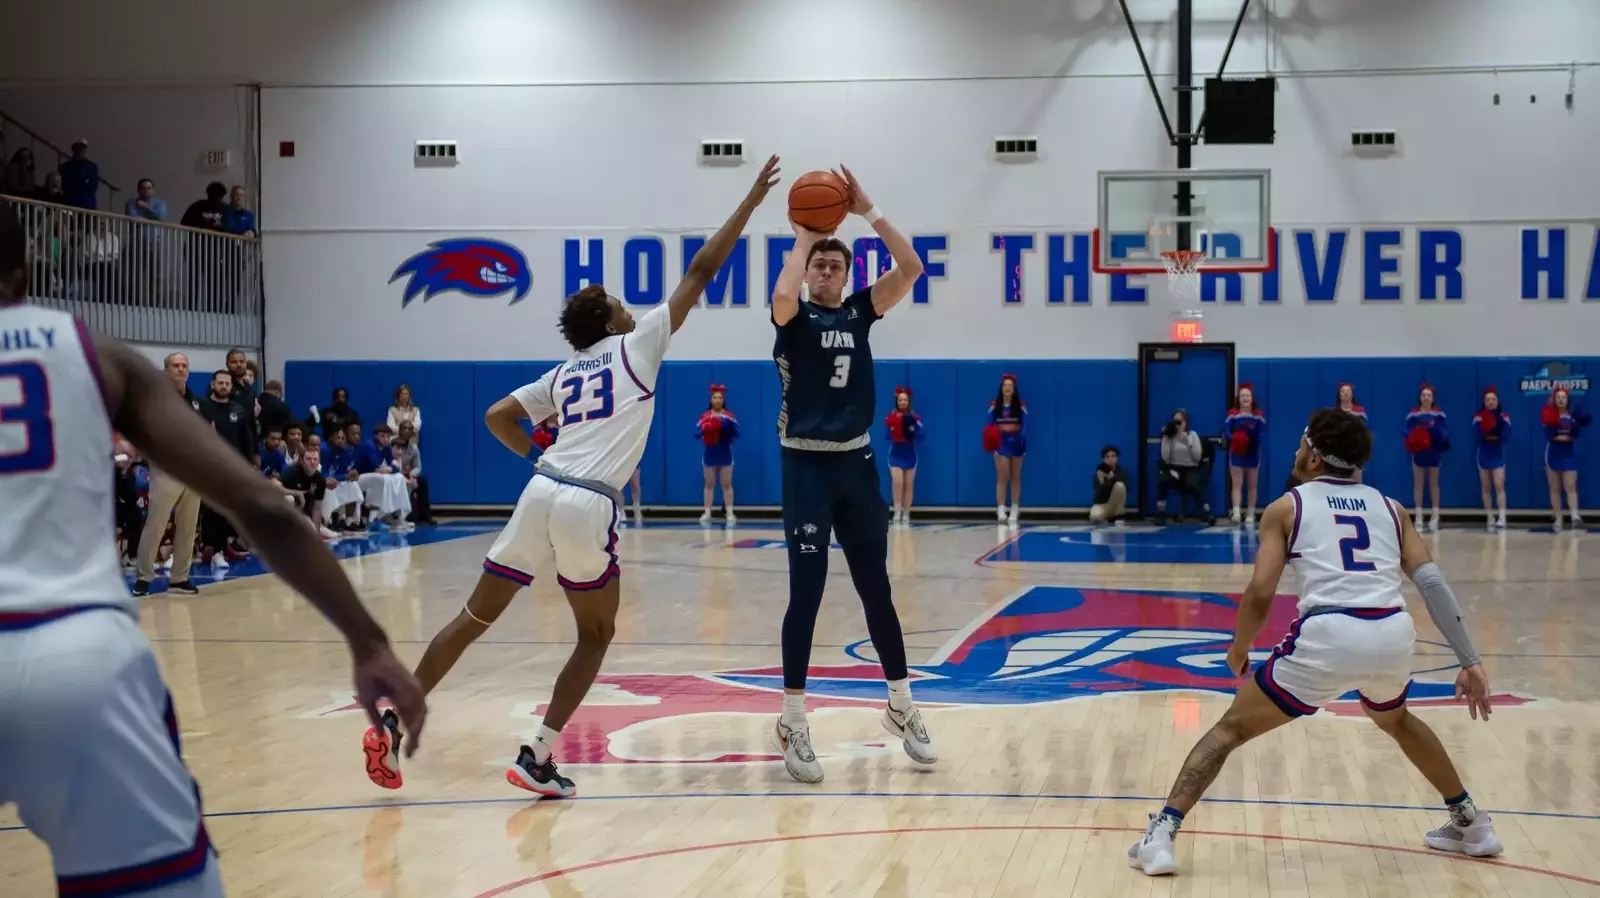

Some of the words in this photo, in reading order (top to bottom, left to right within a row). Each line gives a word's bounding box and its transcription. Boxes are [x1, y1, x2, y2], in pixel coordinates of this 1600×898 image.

[208, 151, 224, 165] EXIT
[850, 235, 950, 305] OF
[990, 232, 1149, 305] THE
[1199, 229, 1465, 304] RIVER
[0, 327, 56, 351] HLY
[1177, 323, 1196, 337] EXIT
[564, 356, 602, 376] MORRIS
[829, 354, 852, 388] 3
[1521, 379, 1589, 391] #AEPLAYOFFS
[561, 367, 614, 427] 23
[1326, 496, 1367, 512] HIKIM
[1333, 513, 1378, 572] 2
